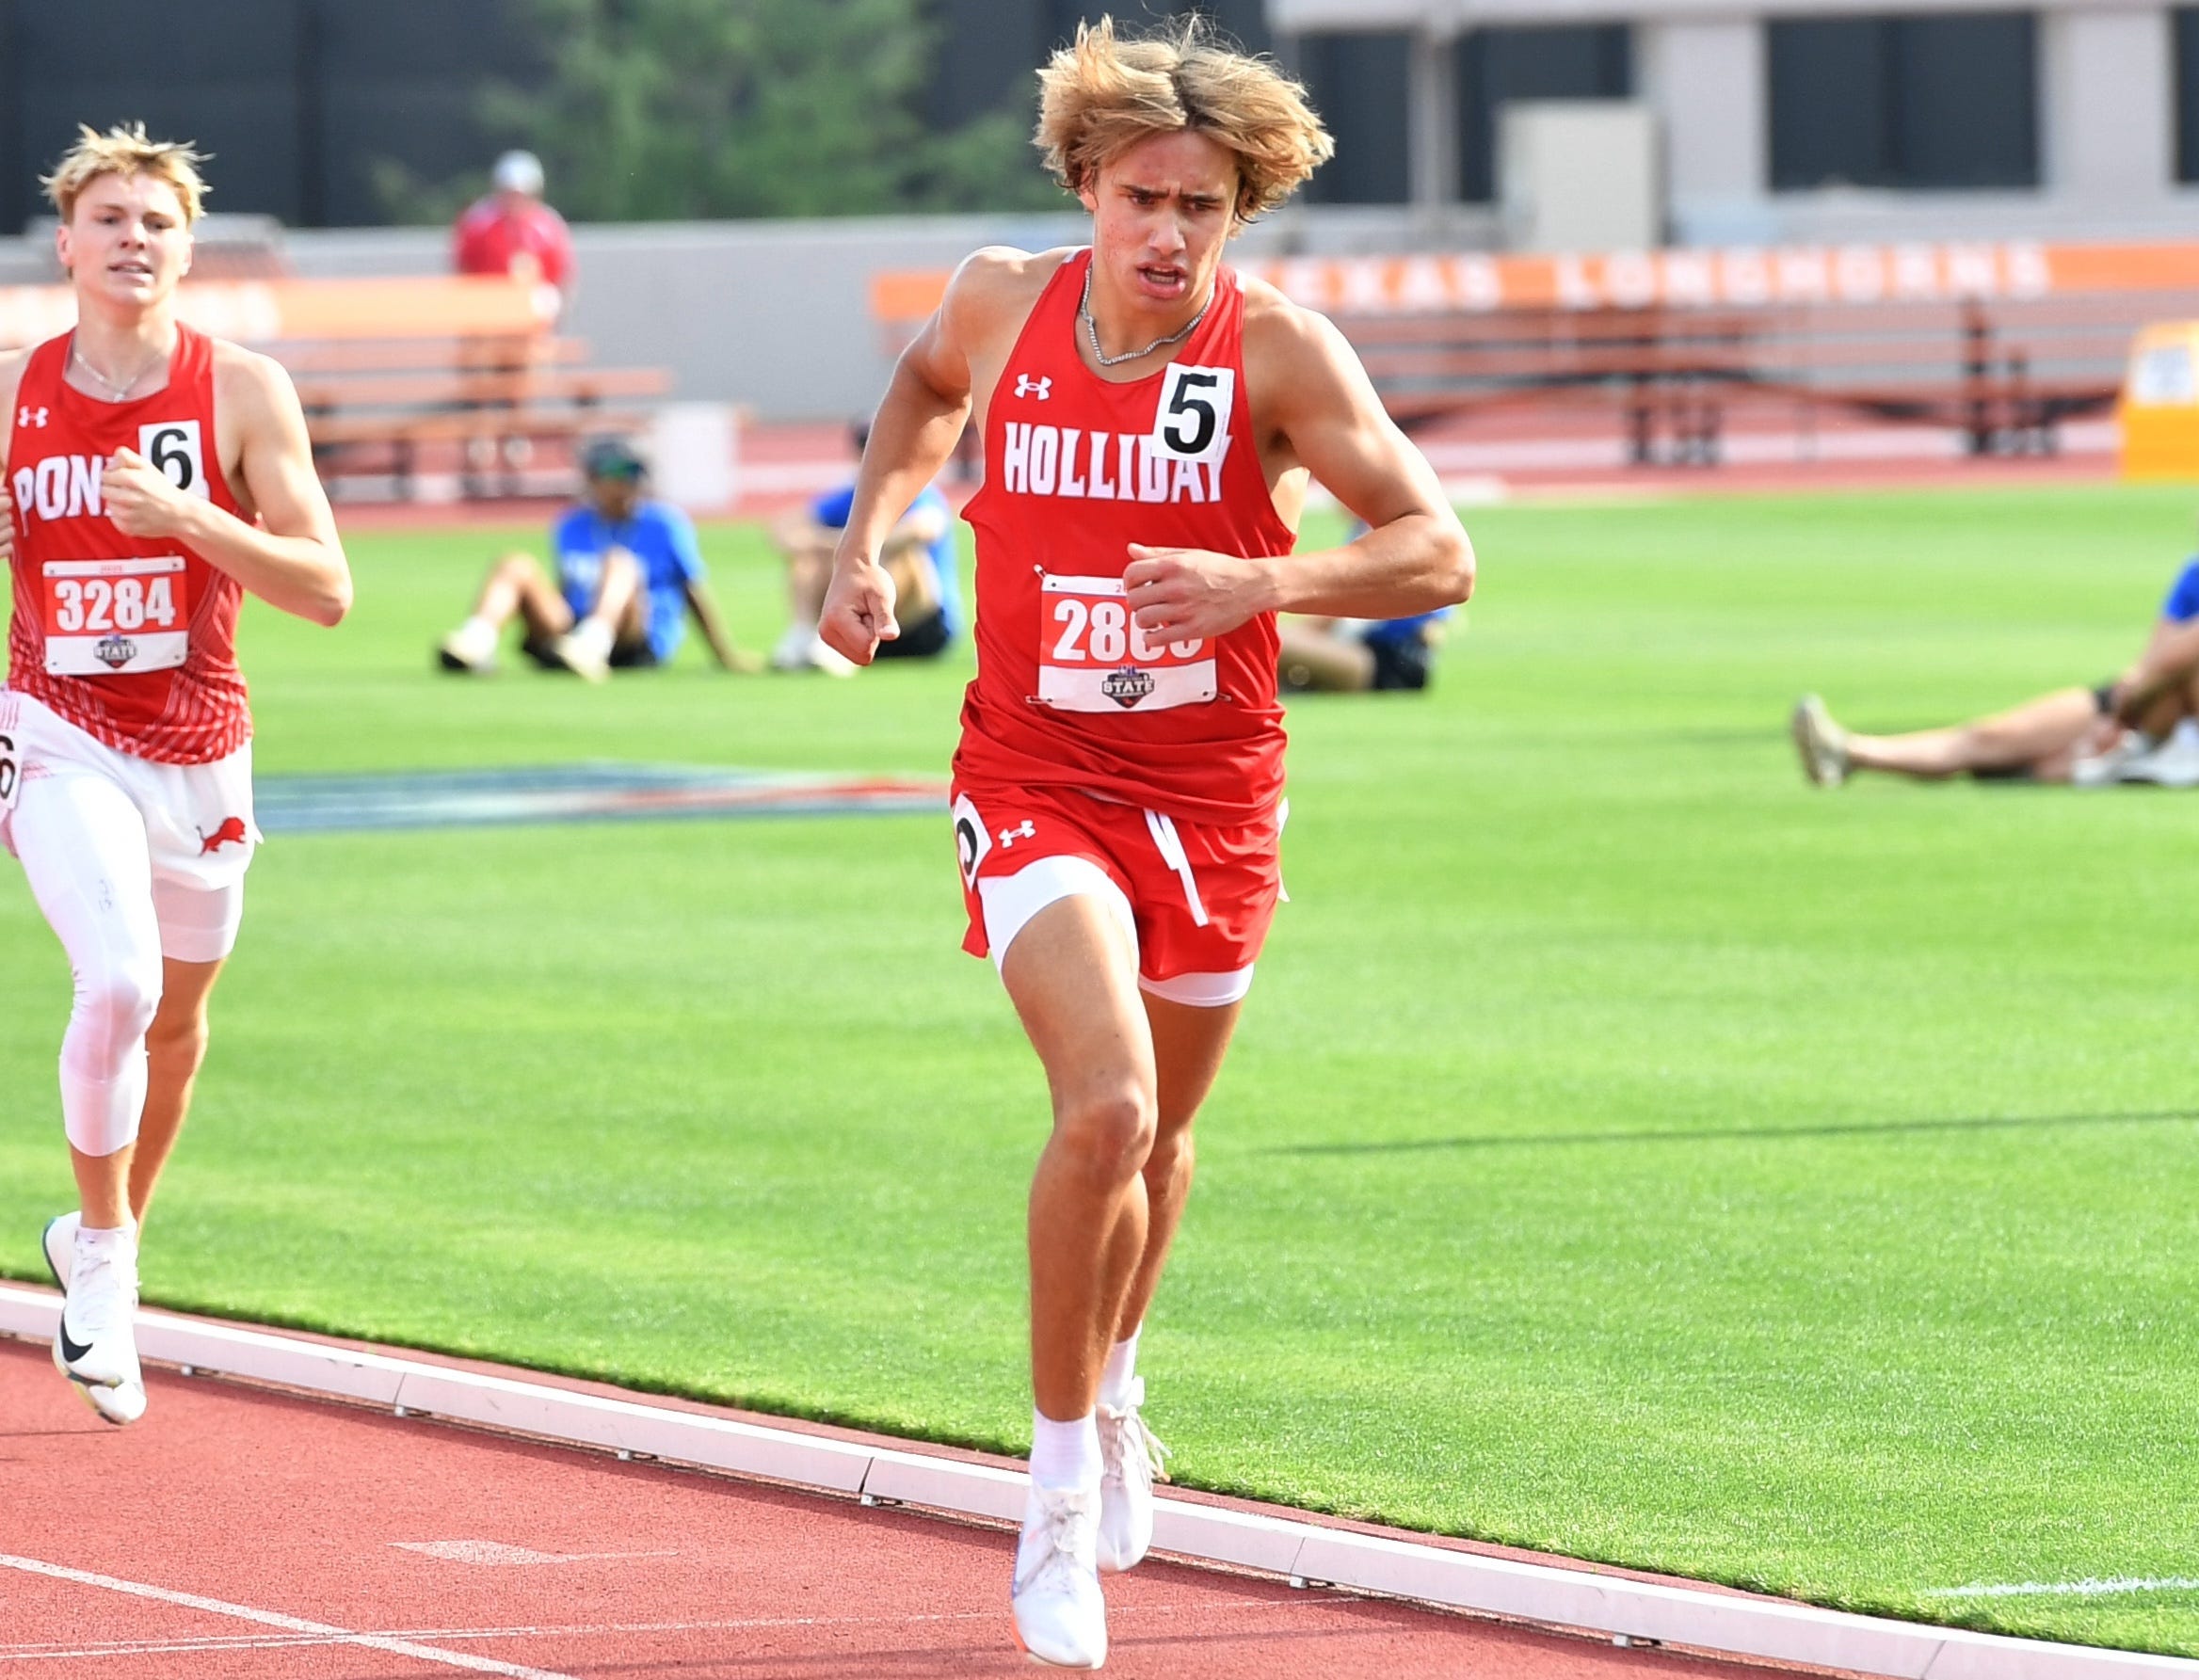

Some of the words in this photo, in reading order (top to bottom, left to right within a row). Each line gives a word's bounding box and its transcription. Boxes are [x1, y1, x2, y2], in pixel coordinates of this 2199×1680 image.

[1241, 254, 1501, 314] EXAS
[1164, 373, 1217, 454] 5
[152, 428, 193, 490] 6
[1003, 421, 1232, 503] HOLLIDAY
[13, 454, 114, 536] PON
[55, 576, 177, 632] 3284
[1102, 680, 1154, 694] STATE
